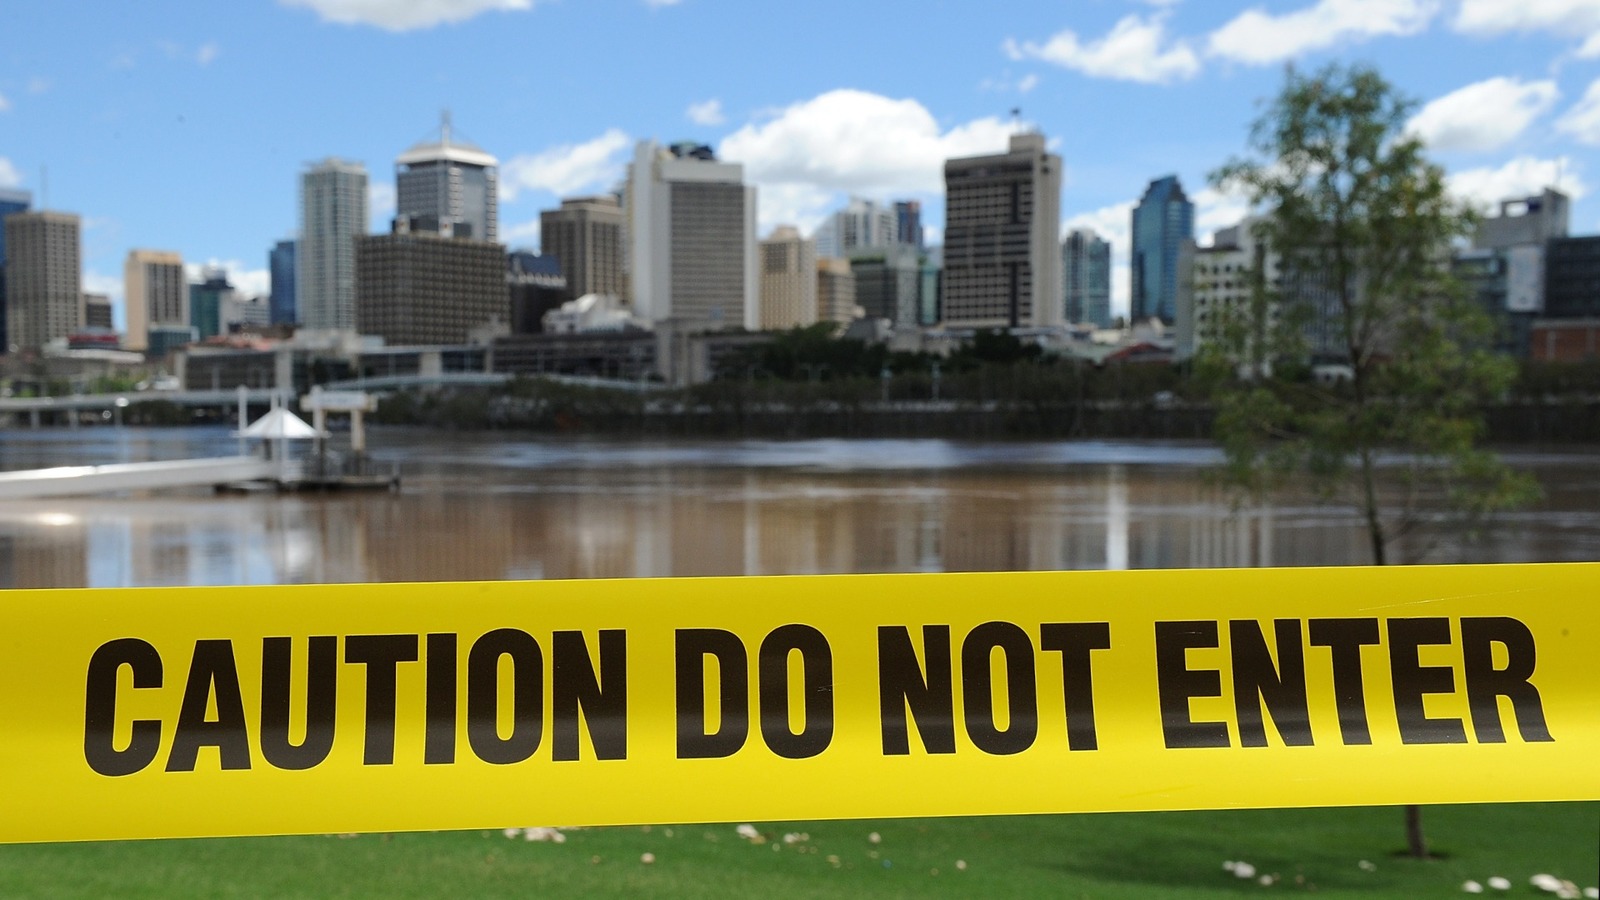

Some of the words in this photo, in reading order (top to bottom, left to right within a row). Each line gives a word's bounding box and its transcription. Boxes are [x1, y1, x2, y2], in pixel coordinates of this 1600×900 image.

[83, 627, 628, 777] CAUTION
[675, 623, 834, 760] DO
[878, 621, 1111, 756] NOT
[1155, 616, 1556, 749] ENTER
